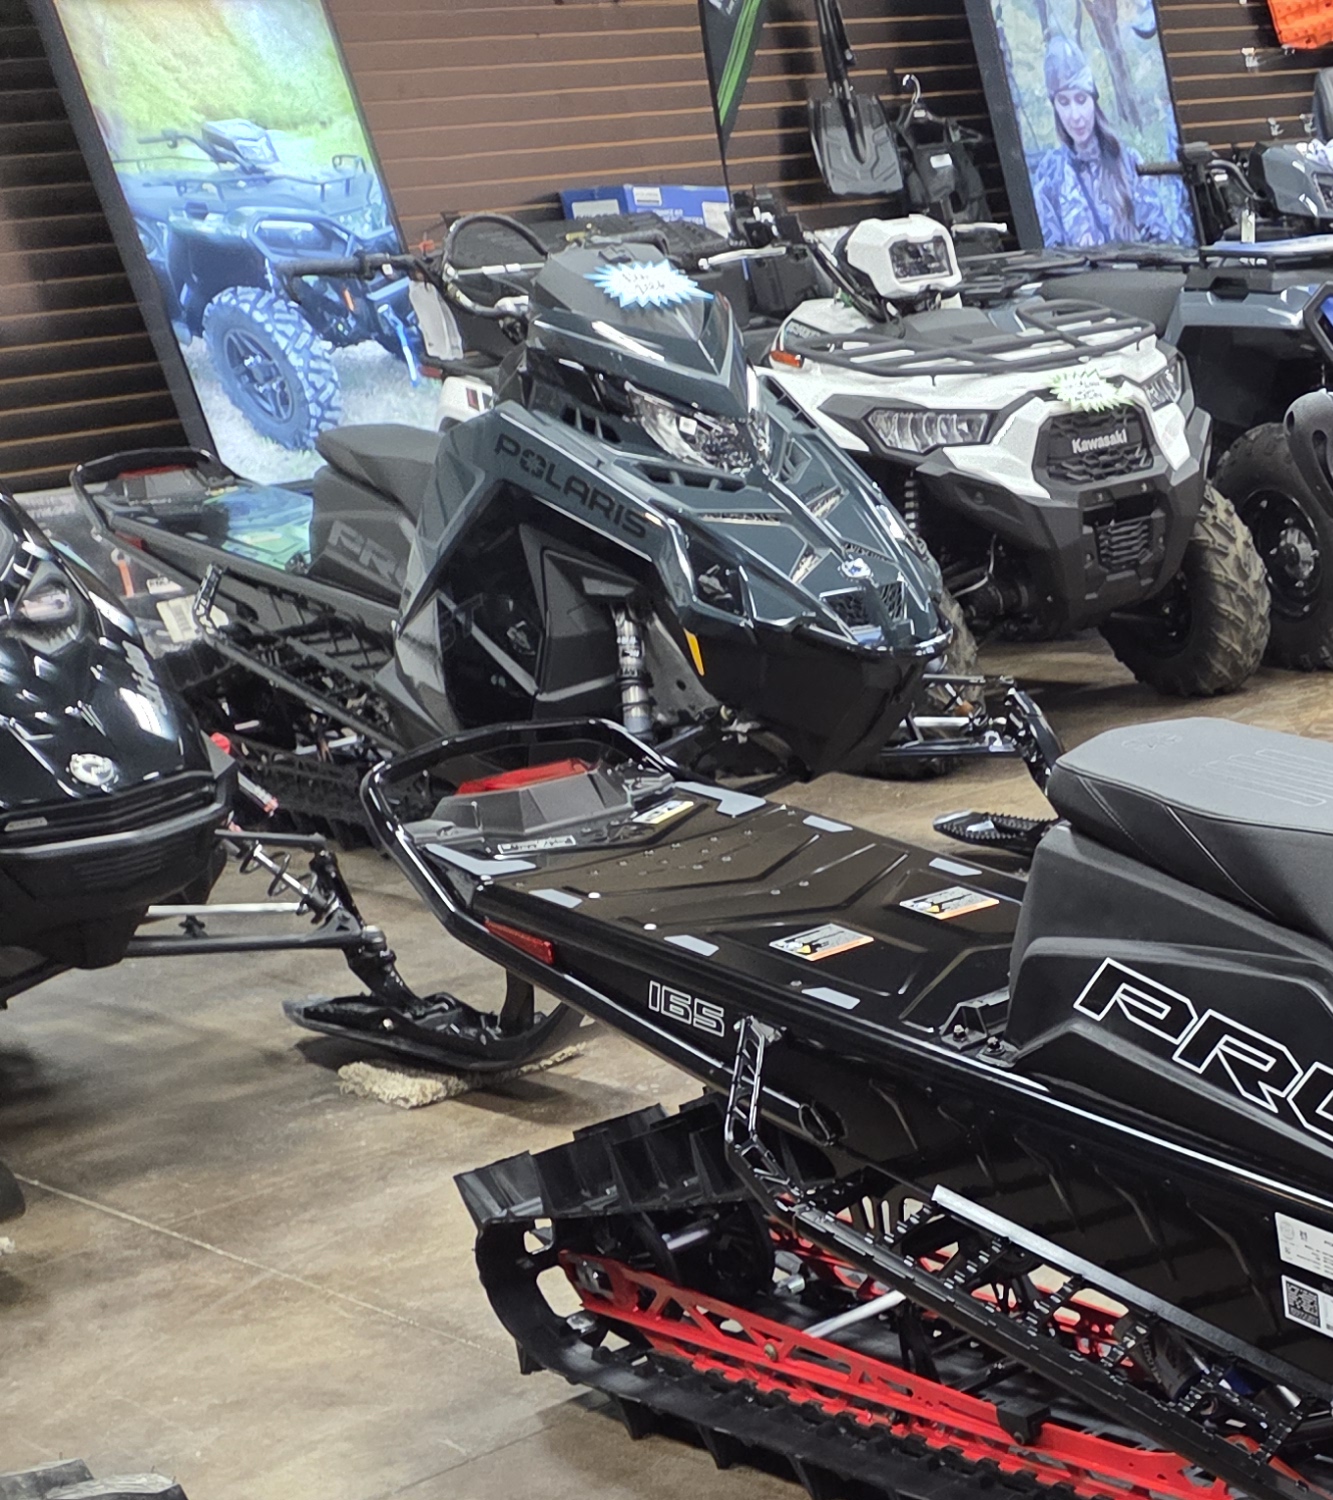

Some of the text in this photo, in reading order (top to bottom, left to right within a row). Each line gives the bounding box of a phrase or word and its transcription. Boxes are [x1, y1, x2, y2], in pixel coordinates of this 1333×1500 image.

[1071, 428, 1128, 454] Kawasaki
[494, 432, 651, 540] POLARIS
[648, 978, 725, 1038] 165
